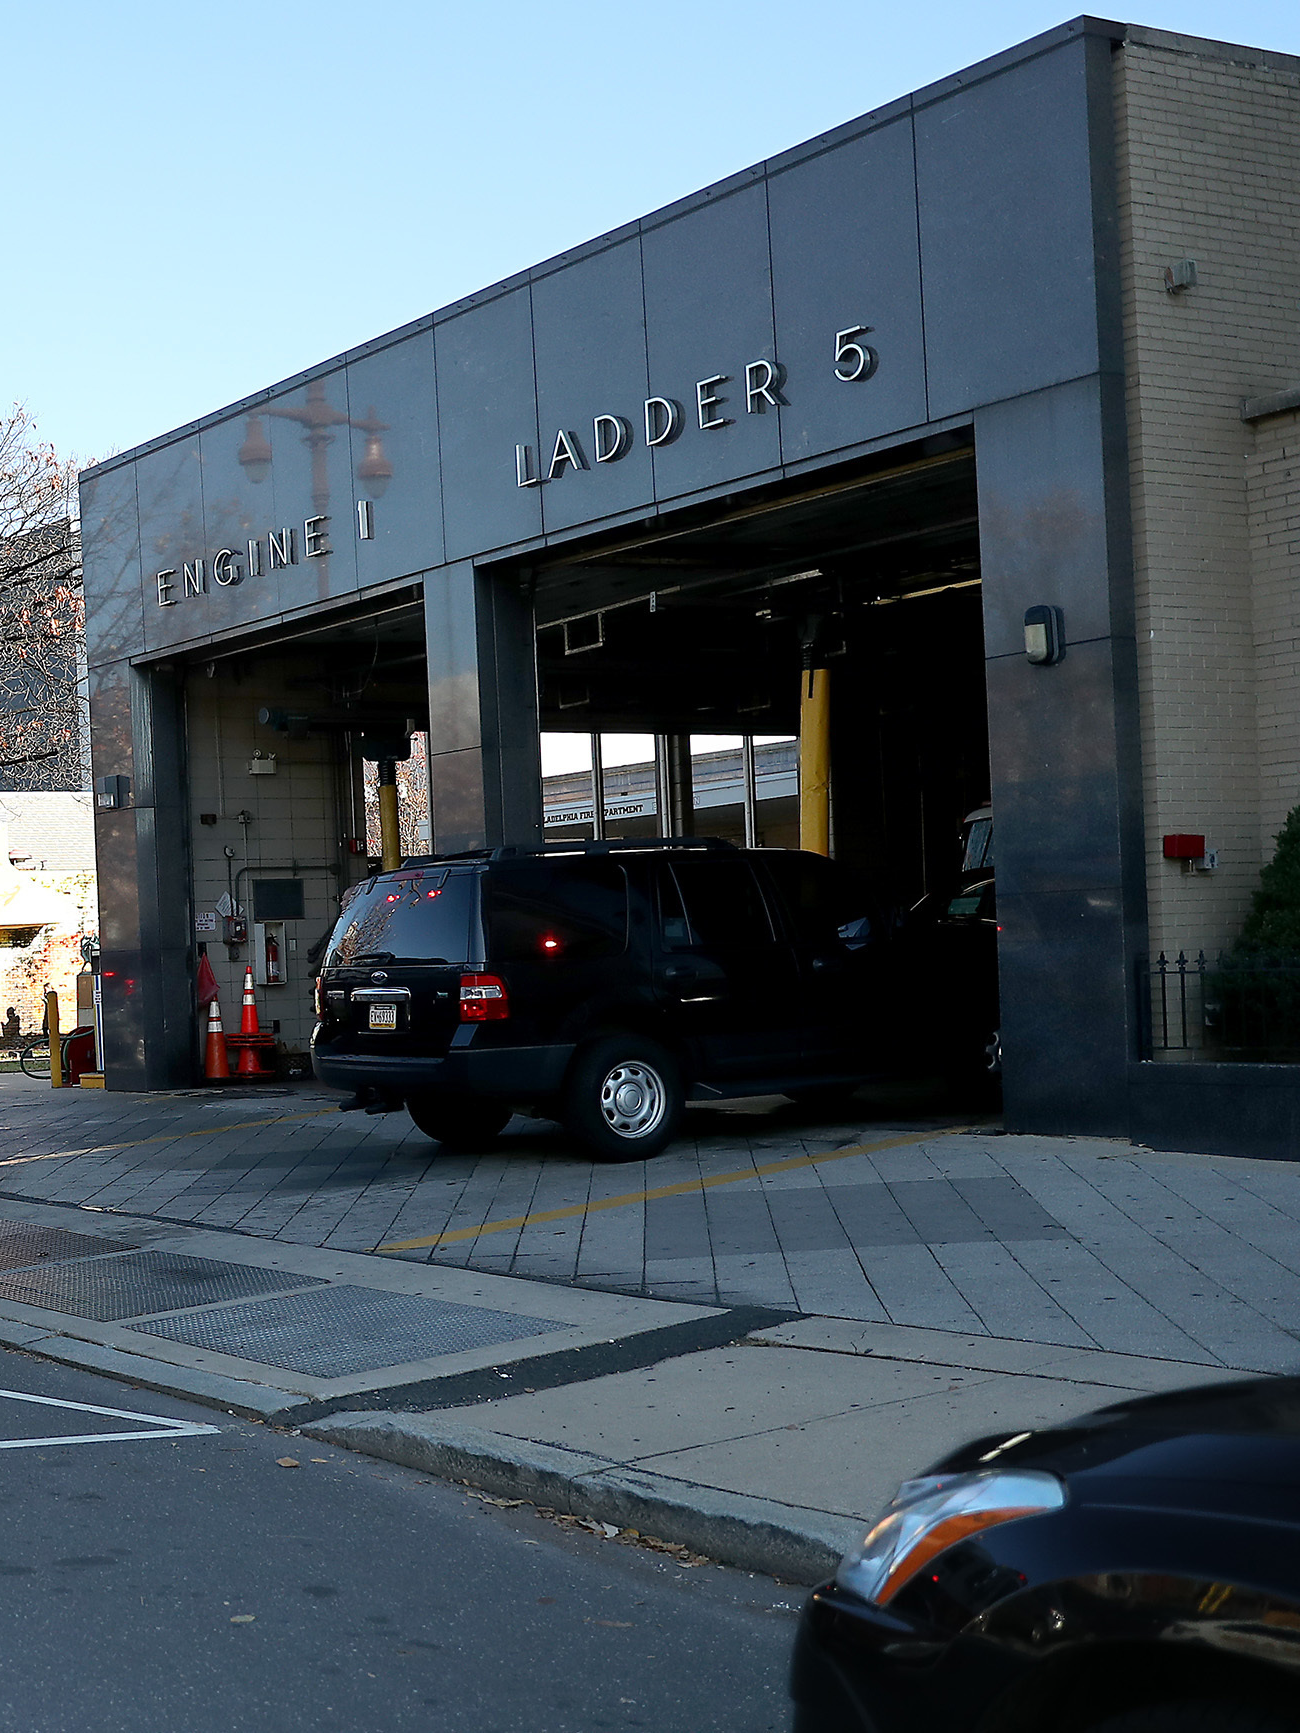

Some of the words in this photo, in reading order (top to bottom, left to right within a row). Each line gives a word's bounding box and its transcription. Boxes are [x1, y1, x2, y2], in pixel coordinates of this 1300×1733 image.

[515, 358, 786, 488] LADDER
[833, 324, 876, 383] 5
[156, 514, 331, 608] ENGINE
[543, 812, 579, 824] LADELPHIA
[579, 810, 595, 820] FIRE
[603, 803, 644, 817] PARTMENT
